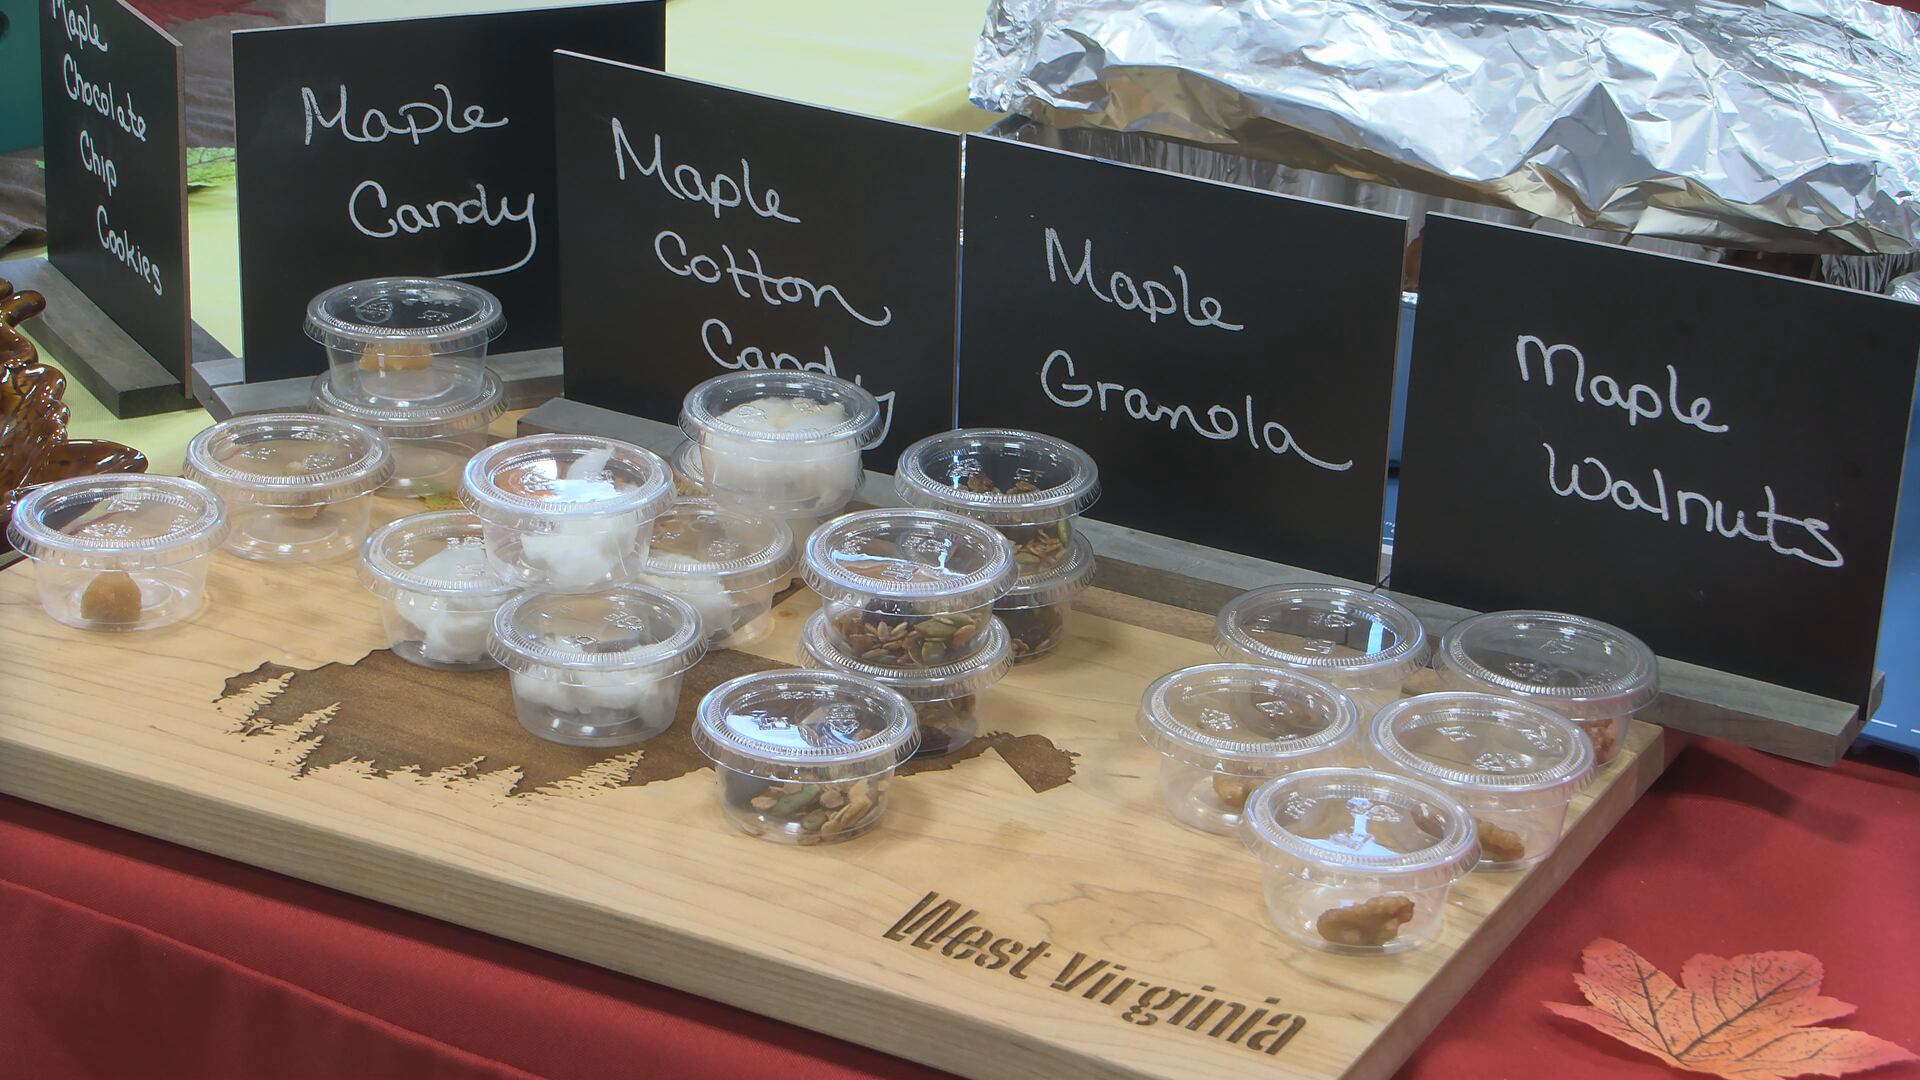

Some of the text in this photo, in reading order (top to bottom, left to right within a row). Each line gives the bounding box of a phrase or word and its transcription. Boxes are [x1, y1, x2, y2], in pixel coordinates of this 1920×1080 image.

[63, 52, 147, 143] Chocolate
[301, 83, 509, 145] Maple
[80, 131, 117, 196] Chip
[611, 117, 800, 224] Maple
[96, 205, 163, 297] Cookies
[348, 180, 537, 280] Candy
[654, 230, 892, 328] Cotton
[1044, 227, 1245, 331] Maple
[1040, 349, 1353, 472] Granola
[1516, 334, 1729, 433] Maple
[1542, 442, 1845, 568] Walnuts
[882, 890, 1306, 1056] West Virginia
